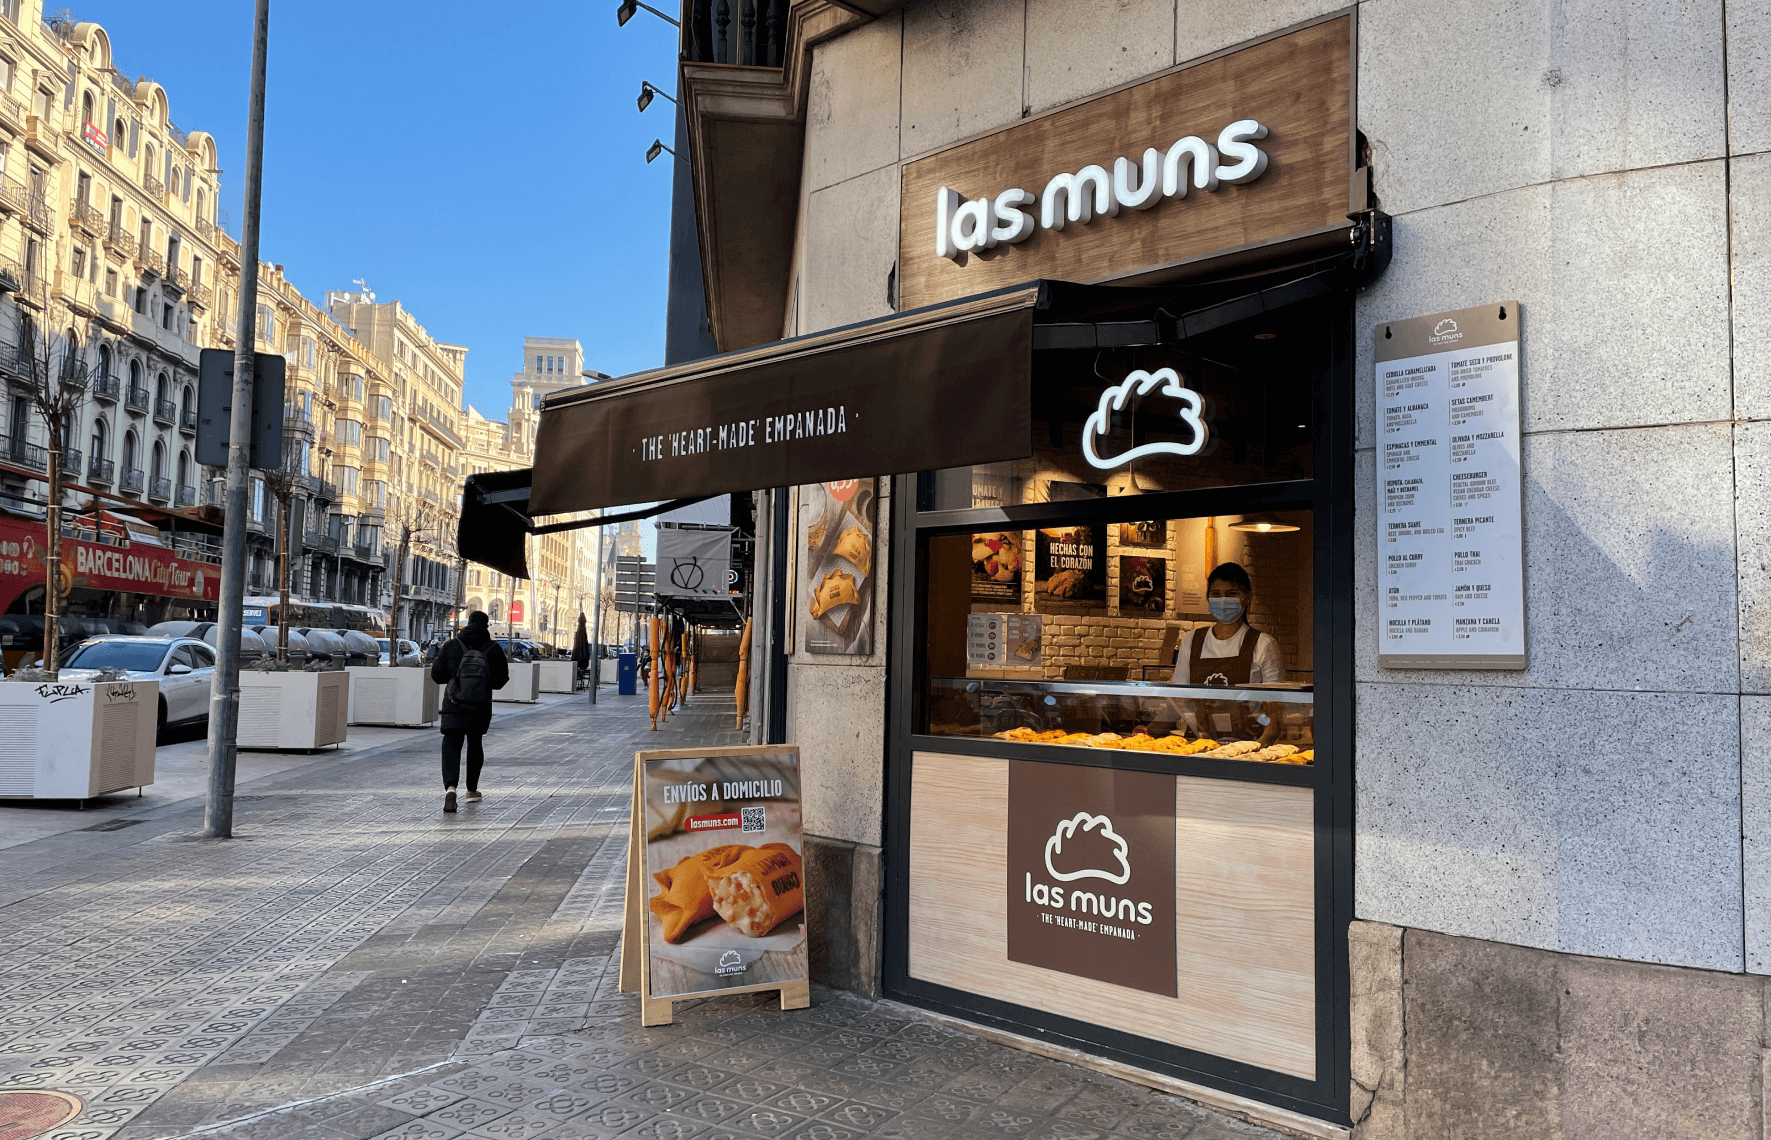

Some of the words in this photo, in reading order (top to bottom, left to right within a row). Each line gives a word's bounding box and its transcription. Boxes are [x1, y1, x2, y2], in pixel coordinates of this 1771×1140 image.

[936, 186, 1035, 258] las
[1041, 120, 1268, 231] muns
[1441, 333, 1463, 341] muns
[1451, 360, 1468, 369] TOMATE
[1469, 358, 1481, 366] SECO
[1486, 353, 1513, 363] PROVOLONE
[1386, 370, 1404, 378] CEBOLLA
[1405, 365, 1436, 375] CARAMELIZADA
[1451, 398, 1466, 406] SETAS
[1466, 394, 1494, 404] CAMEMBERT
[641, 435, 664, 462] THE
[765, 405, 847, 443] EMPANADA
[1451, 435, 1470, 443] OLIVADA
[1475, 431, 1504, 440] MOZZARELLA
[1386, 442, 1409, 450] ESPINACAS
[1414, 439, 1437, 447] EMMENTAL
[1452, 471, 1487, 480] CHEESEBURGER
[972, 484, 997, 497] OMATE
[1475, 516, 1494, 524] PICANTE
[1050, 542, 1077, 556] HECHAS
[1079, 544, 1094, 557] CON
[1050, 555, 1059, 568] EL
[1061, 554, 1093, 570] CORAZÓN
[1409, 553, 1423, 561] CURRY
[77, 546, 150, 582] BARCELONA
[170, 562, 191, 587] Tour
[1454, 584, 1471, 592] JAMÓN
[1476, 584, 1491, 592] QUESO
[1388, 619, 1406, 627] NOCILLA
[1455, 618, 1477, 626] MANZANA
[1482, 617, 1501, 625] CANELA
[663, 781, 708, 803] ENVÍOS
[711, 783, 720, 801] A
[723, 779, 783, 800] DOMICILIO
[690, 818, 739, 829] lasmuns.com
[1025, 872, 1064, 908] las
[1071, 890, 1153, 925] muns
[1041, 913, 1053, 924] THE
[1100, 924, 1135, 940] EMPANADA
[715, 966, 726, 974] las
[726, 965, 747, 973] muns
